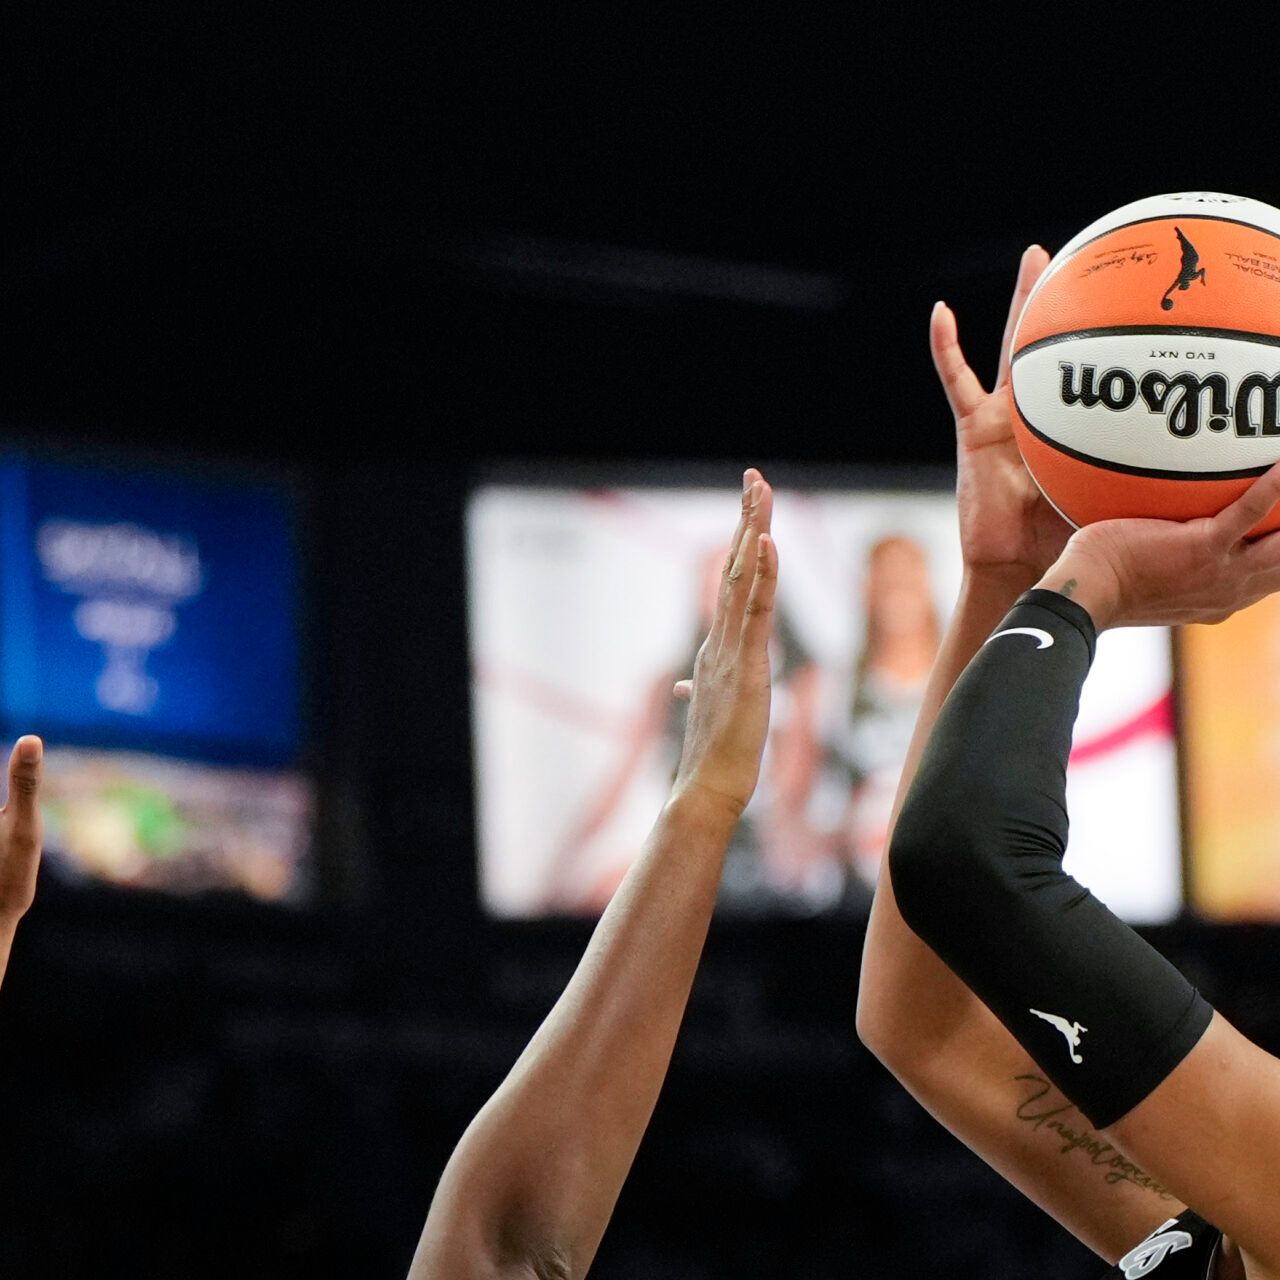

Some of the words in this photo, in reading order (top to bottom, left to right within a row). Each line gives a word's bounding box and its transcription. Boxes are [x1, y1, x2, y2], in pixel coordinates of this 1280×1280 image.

[1224, 253, 1260, 266] BALL
[1149, 351, 1179, 359] NXT
[1186, 352, 1215, 360] EVO
